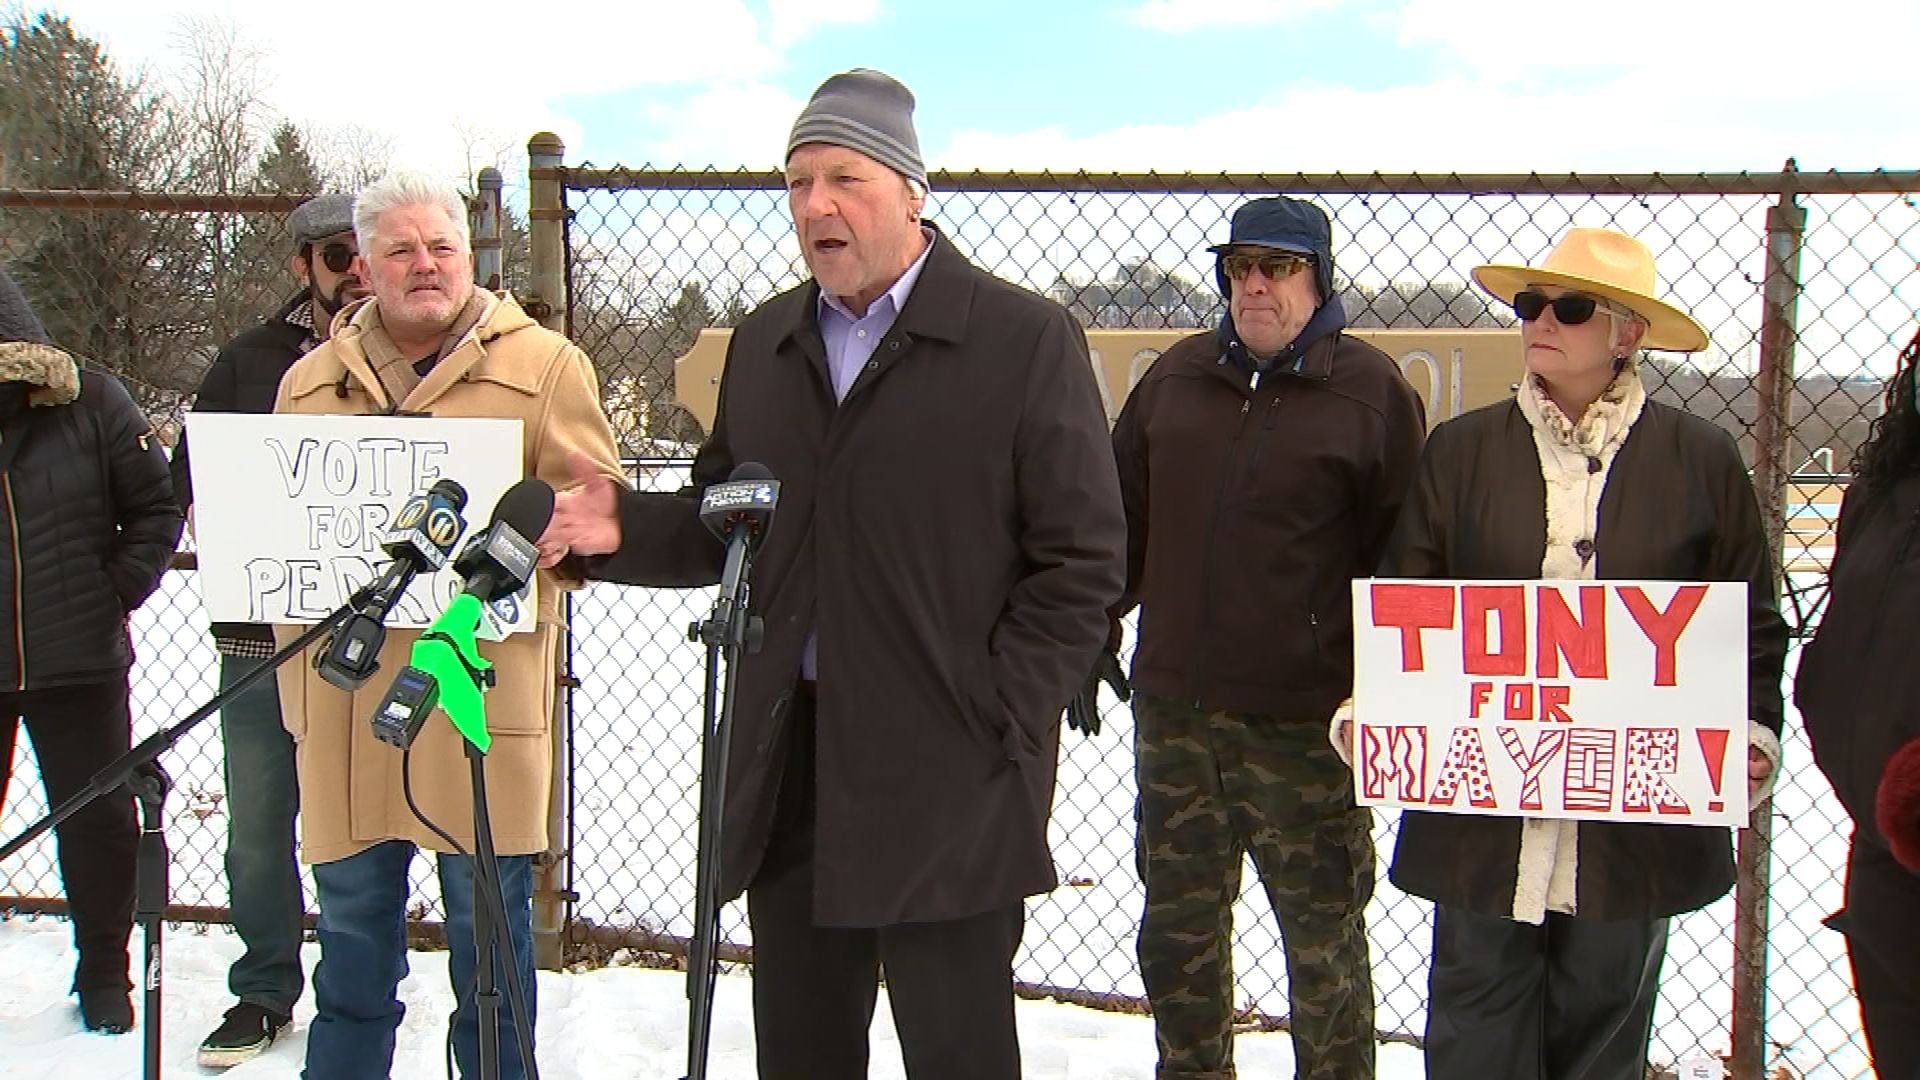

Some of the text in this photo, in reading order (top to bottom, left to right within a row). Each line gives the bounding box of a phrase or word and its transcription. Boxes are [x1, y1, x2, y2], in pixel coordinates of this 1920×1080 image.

[264, 438, 449, 498] VOTE
[306, 503, 390, 552] FOR
[1370, 583, 1710, 686] TONY
[1470, 681, 1573, 722] FOR
[1361, 723, 1730, 814] MAYOR!
